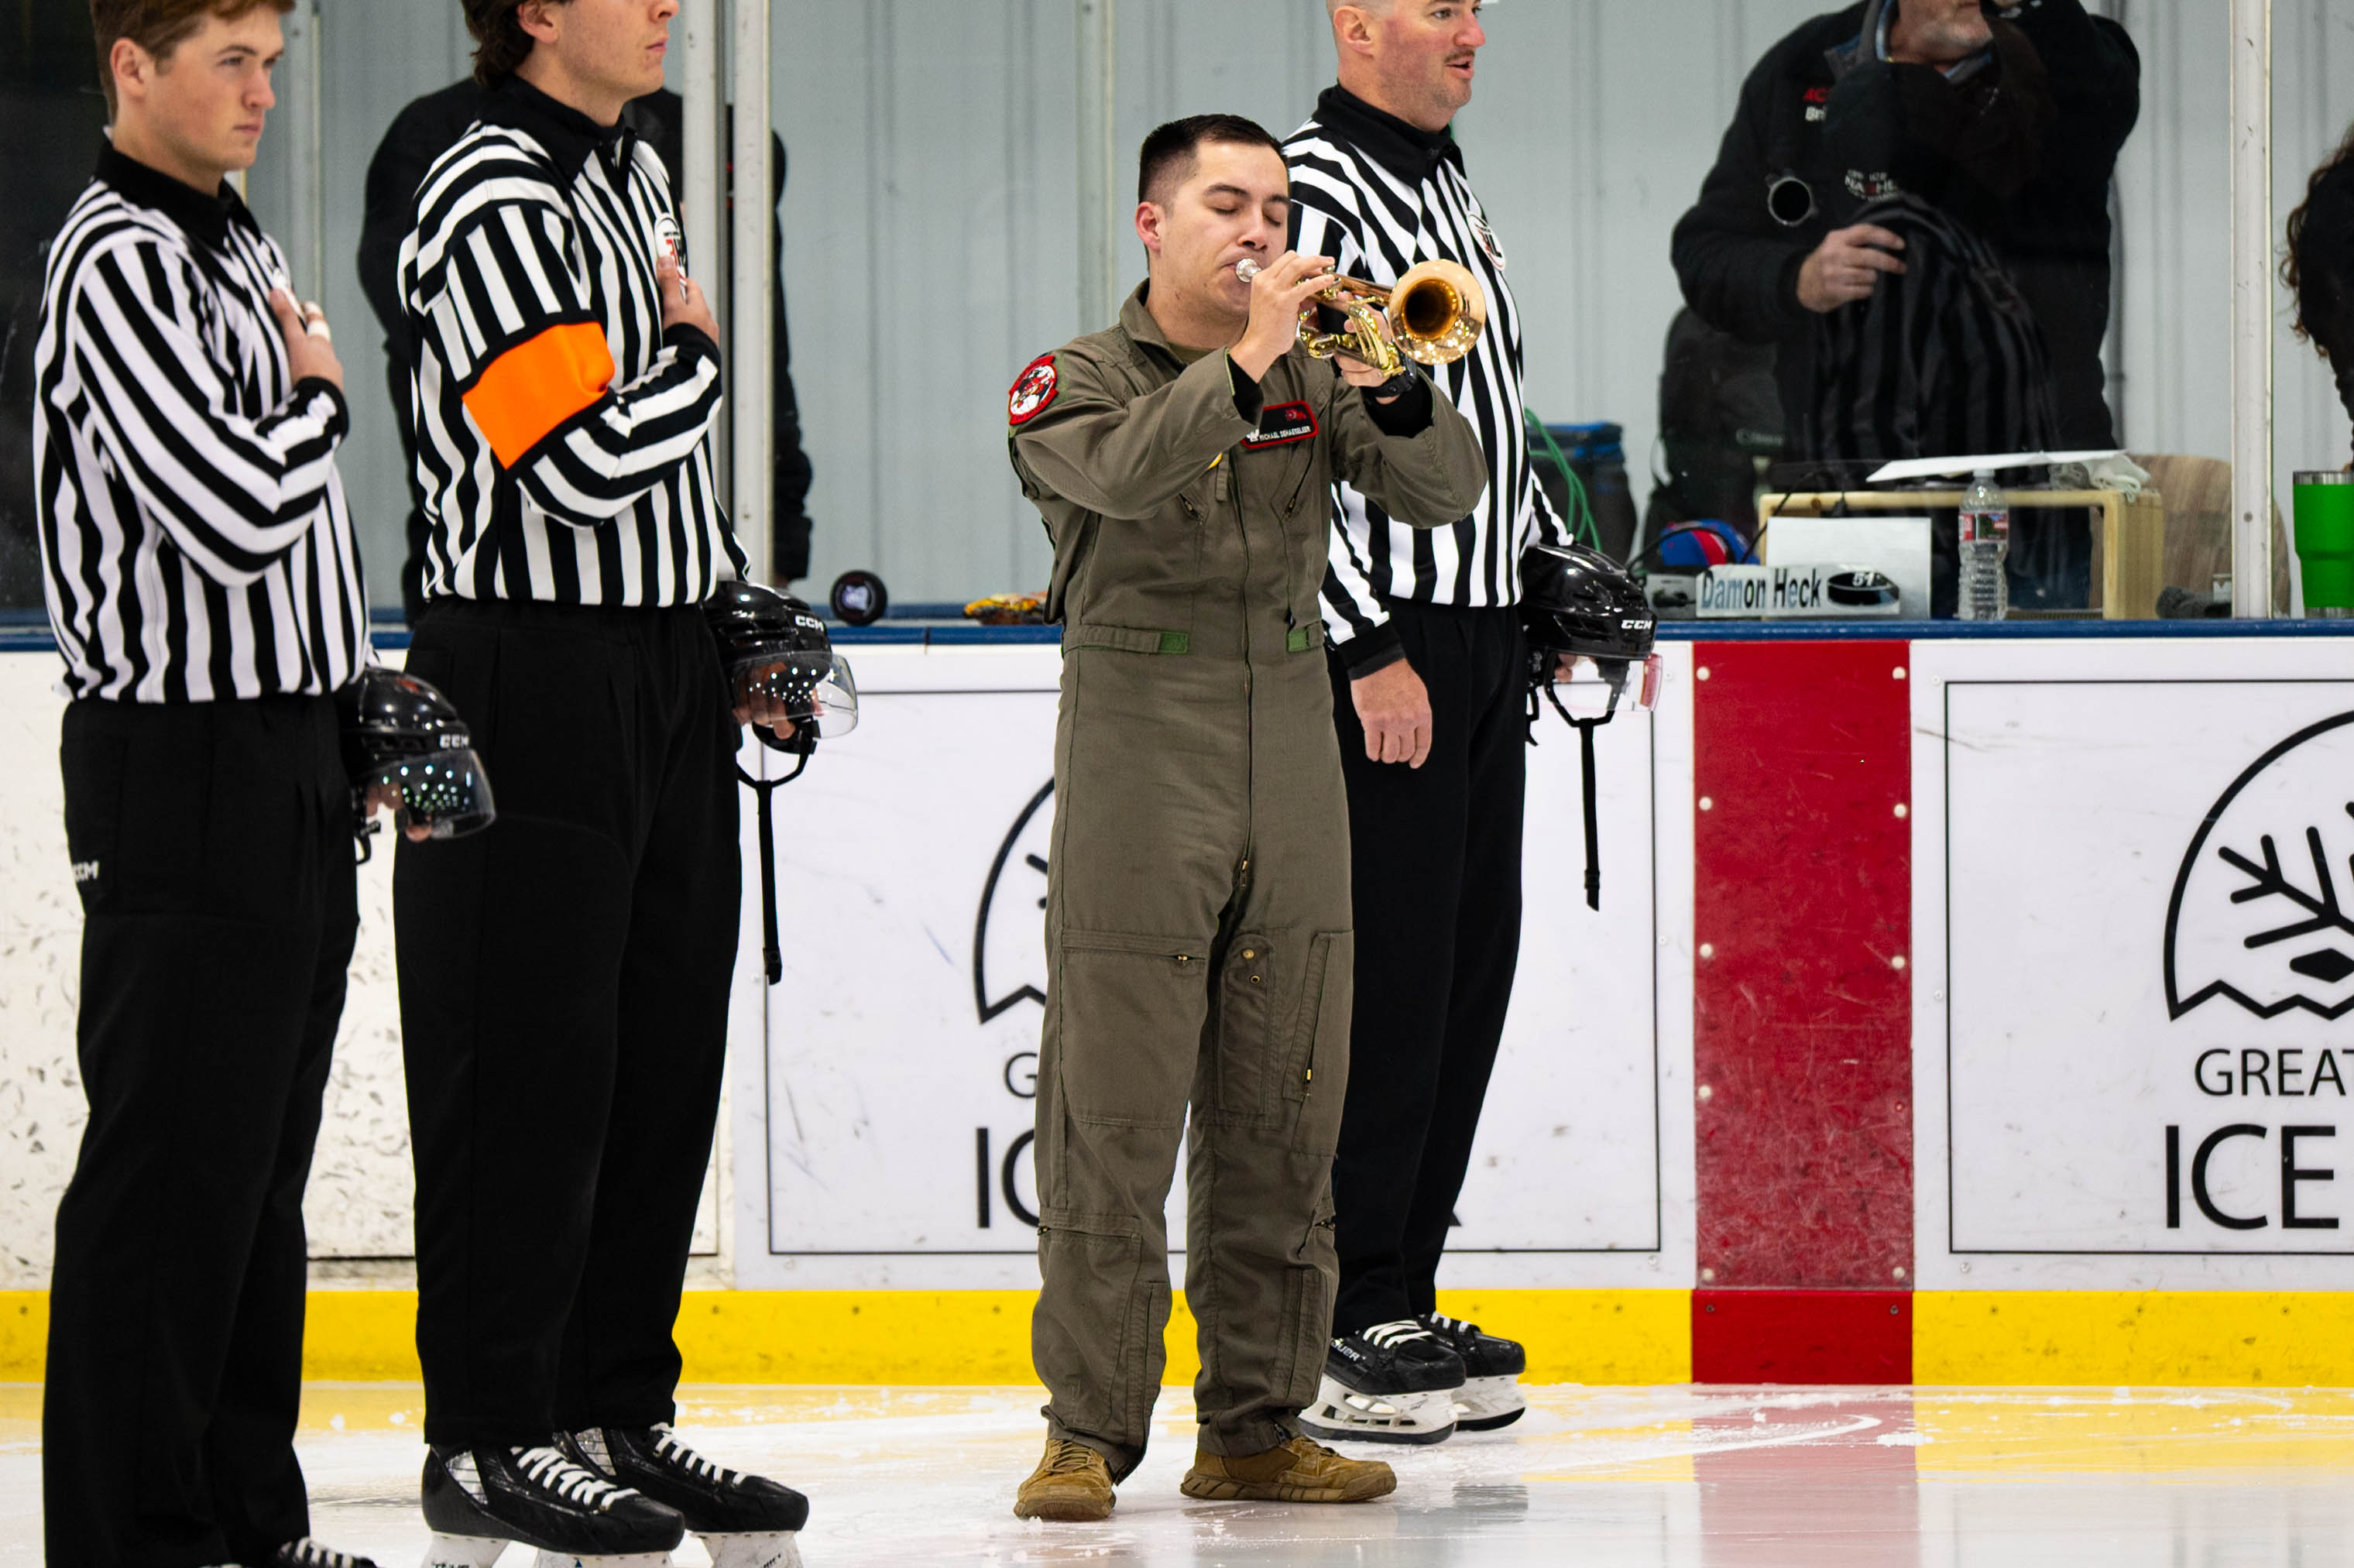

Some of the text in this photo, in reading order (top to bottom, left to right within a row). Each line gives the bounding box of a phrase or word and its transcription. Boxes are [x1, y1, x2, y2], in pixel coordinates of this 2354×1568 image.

[1701, 568, 1875, 609] Damon Heck 51
[795, 615, 825, 632] CCM
[1621, 619, 1652, 630] CCM
[440, 734, 470, 748] CCM
[2166, 1123, 2340, 1230] ICE
